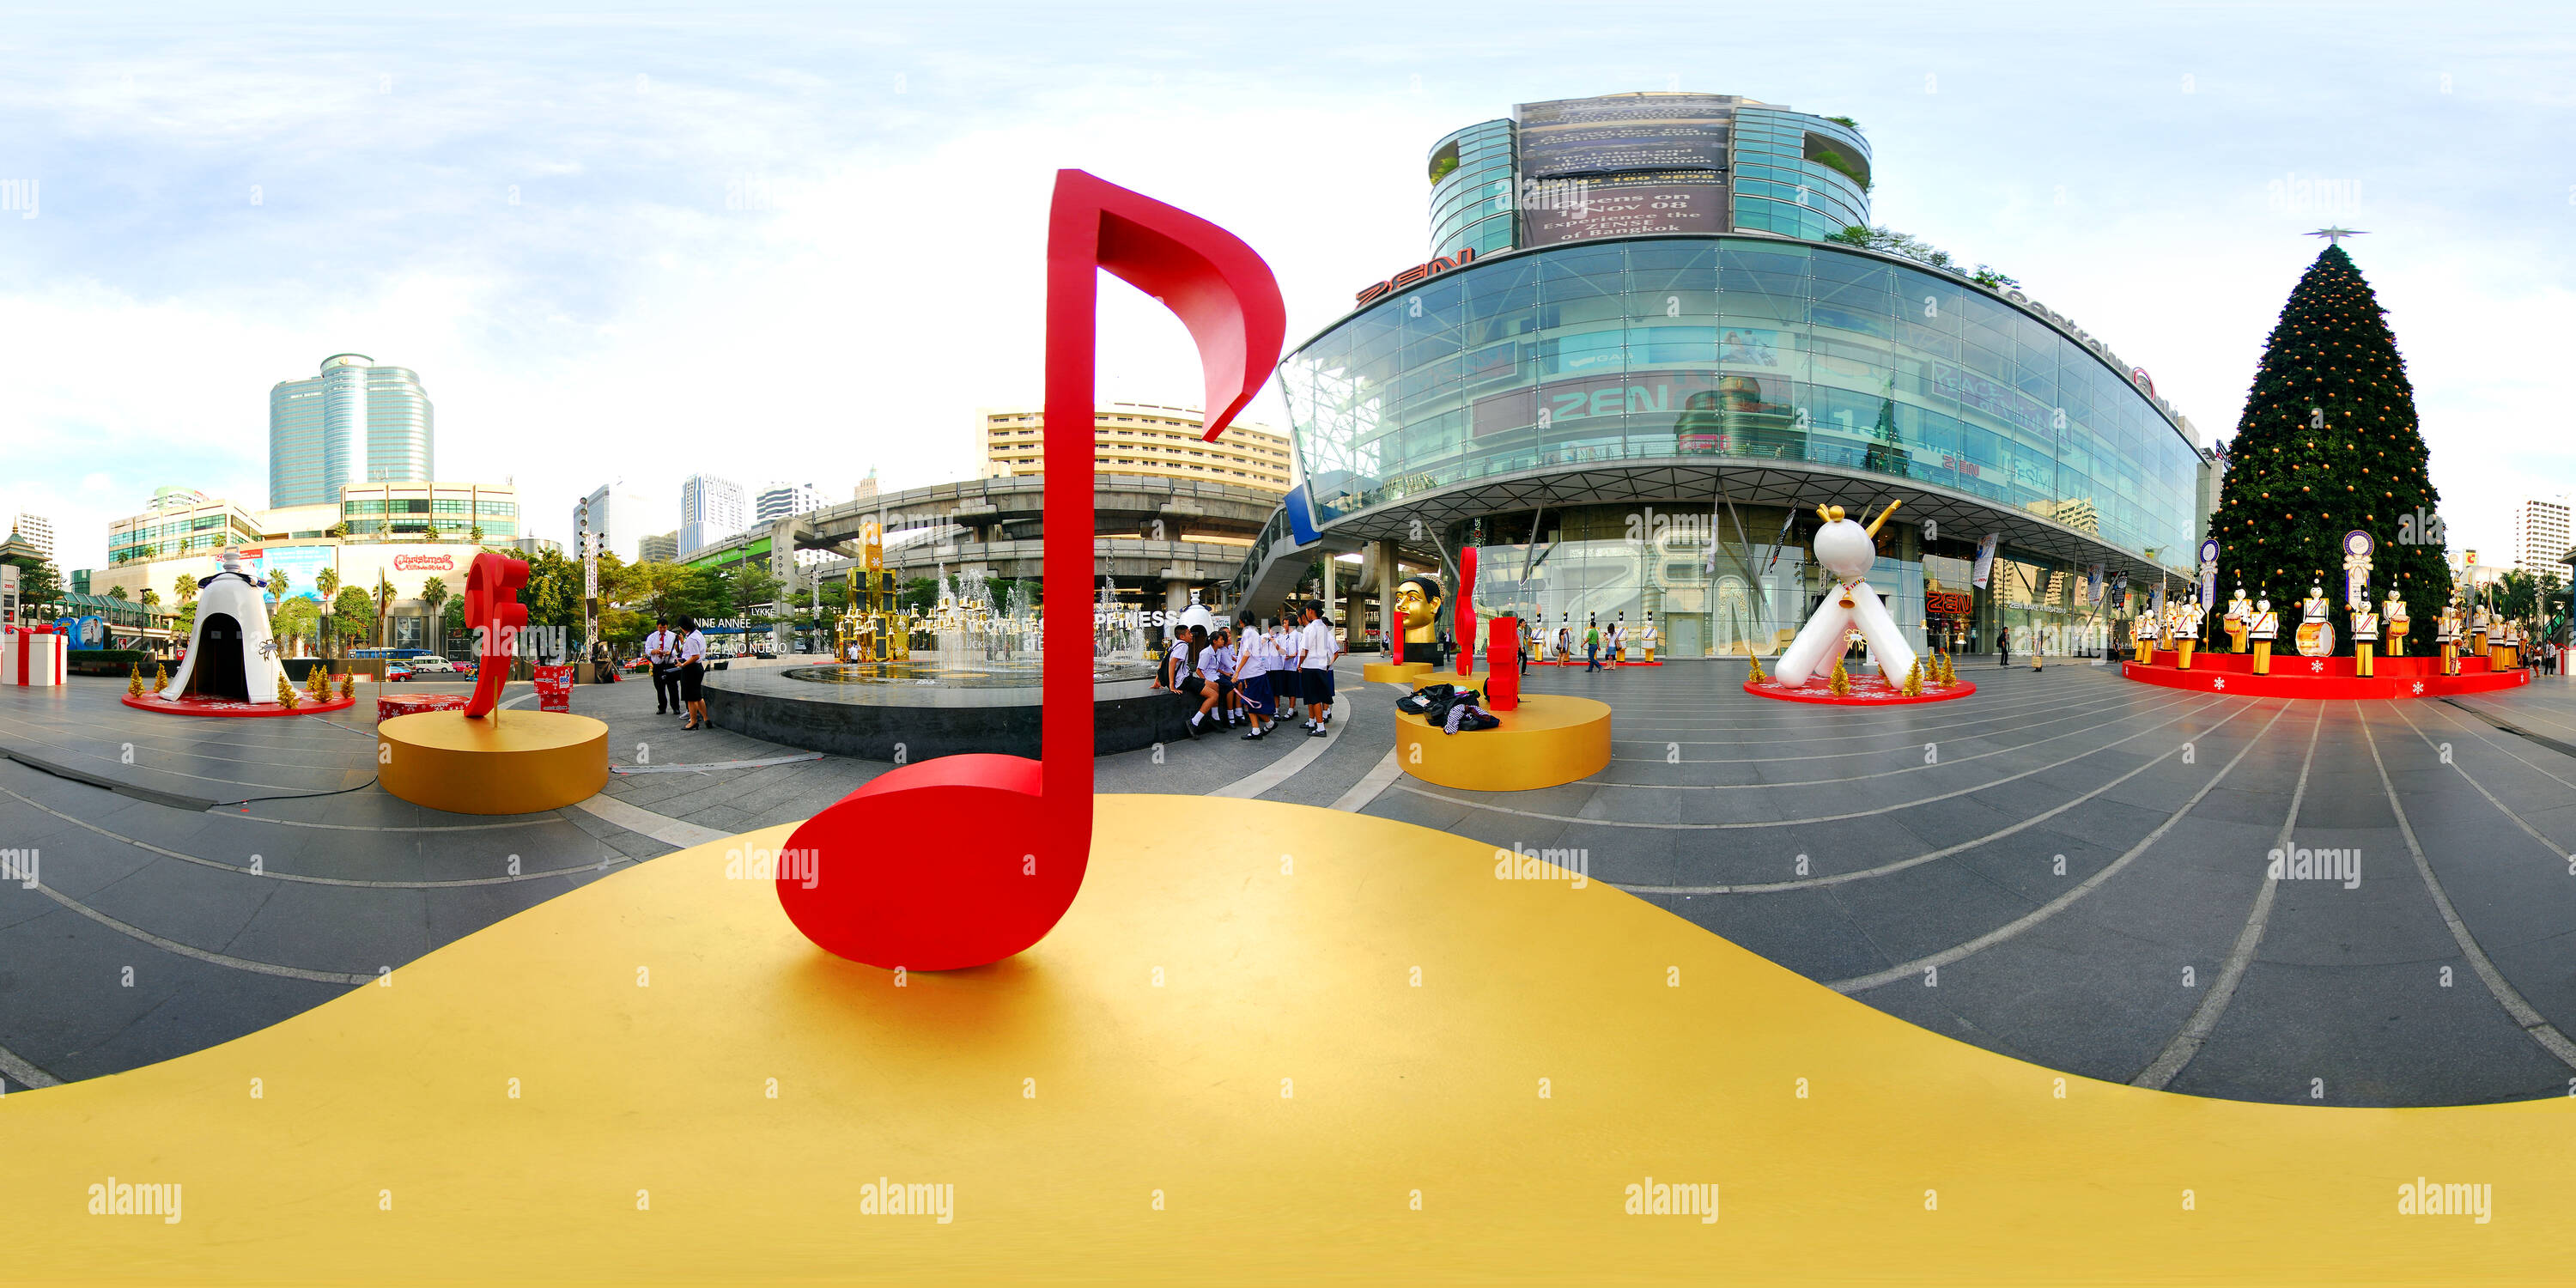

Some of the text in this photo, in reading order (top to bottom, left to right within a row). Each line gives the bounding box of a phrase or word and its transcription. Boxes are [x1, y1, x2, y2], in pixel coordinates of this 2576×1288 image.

[1553, 195, 1644, 208] Opens
[1543, 214, 1658, 230] Experience
[1585, 219, 1656, 231] ZENSE
[1560, 224, 1680, 240] of Bangkok
[1356, 247, 1476, 312] ZEN
[1552, 384, 1668, 421] ZEN
[1927, 591, 1972, 615] ZEN
[749, 642, 787, 653] NUEVO
